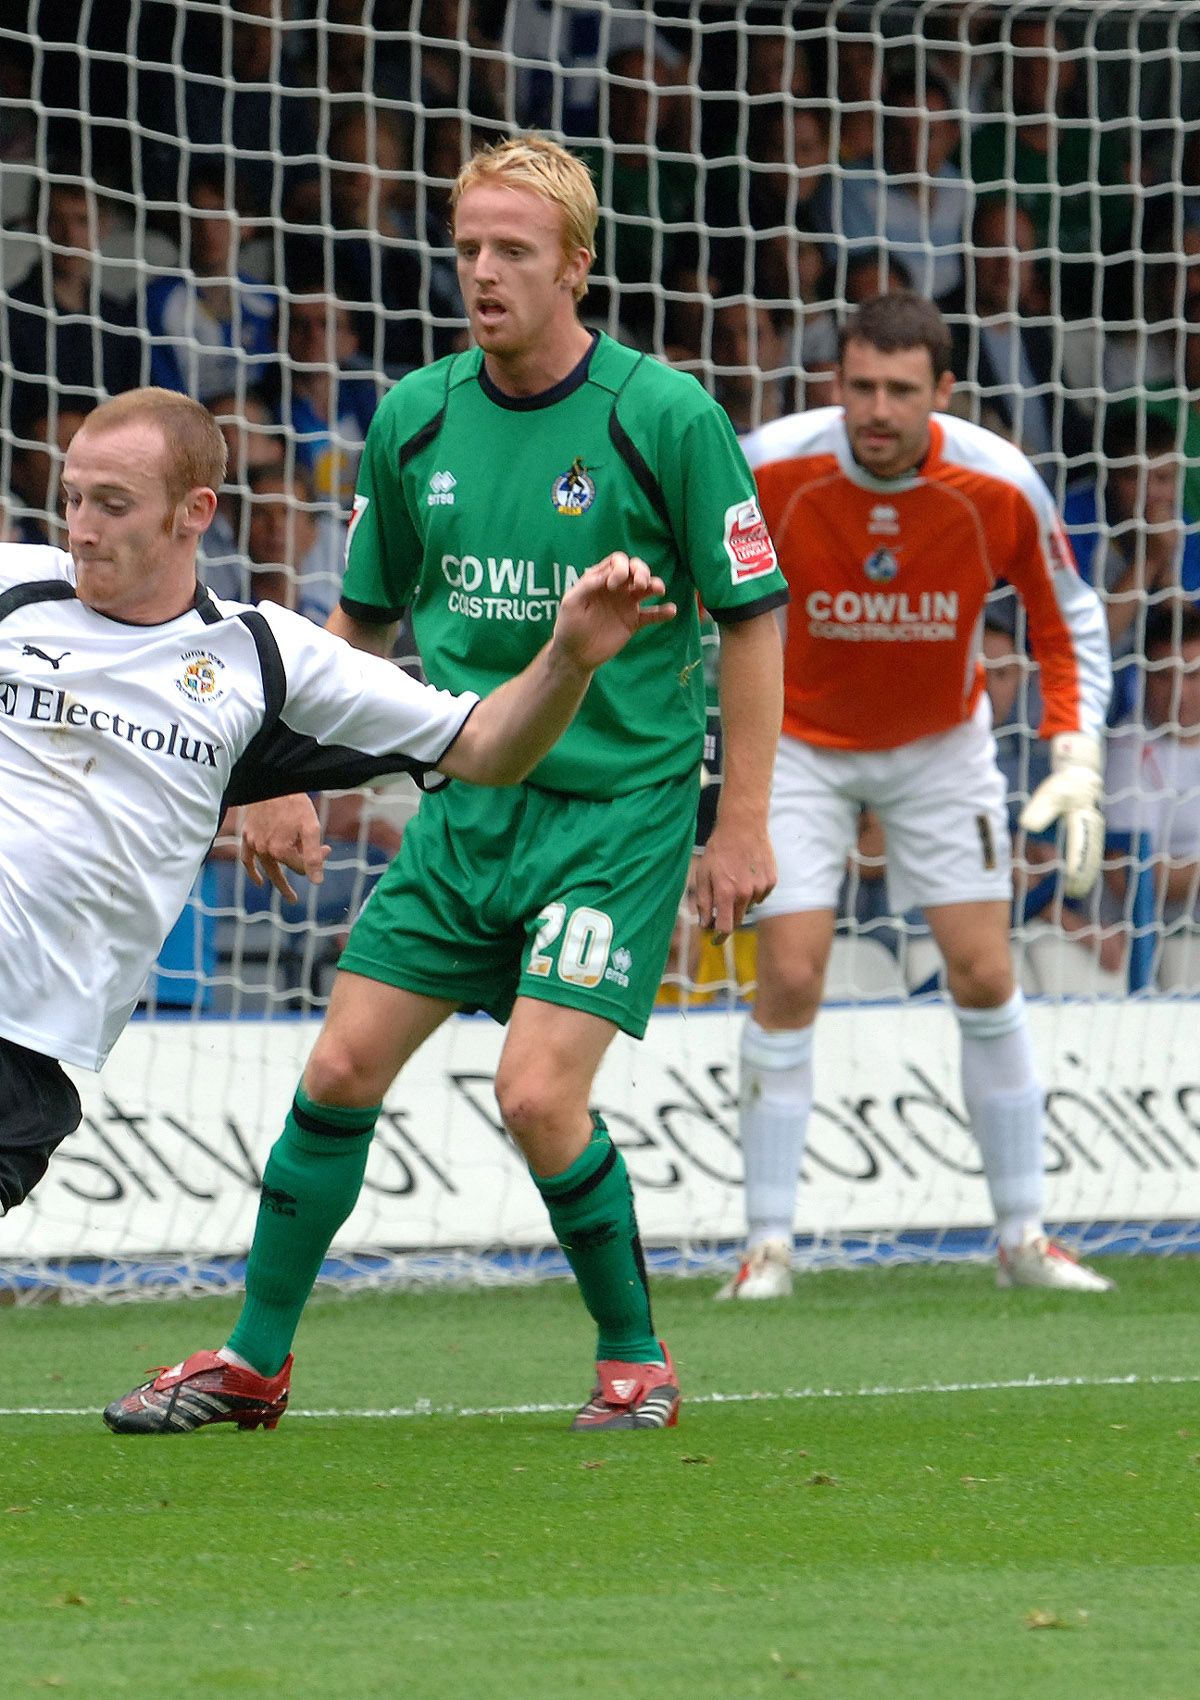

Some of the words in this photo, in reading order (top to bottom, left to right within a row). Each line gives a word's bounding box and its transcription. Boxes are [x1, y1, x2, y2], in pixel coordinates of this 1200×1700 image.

[806, 590, 959, 622] COWLIN
[30, 687, 222, 768] Electrolux
[526, 901, 614, 988] 20
